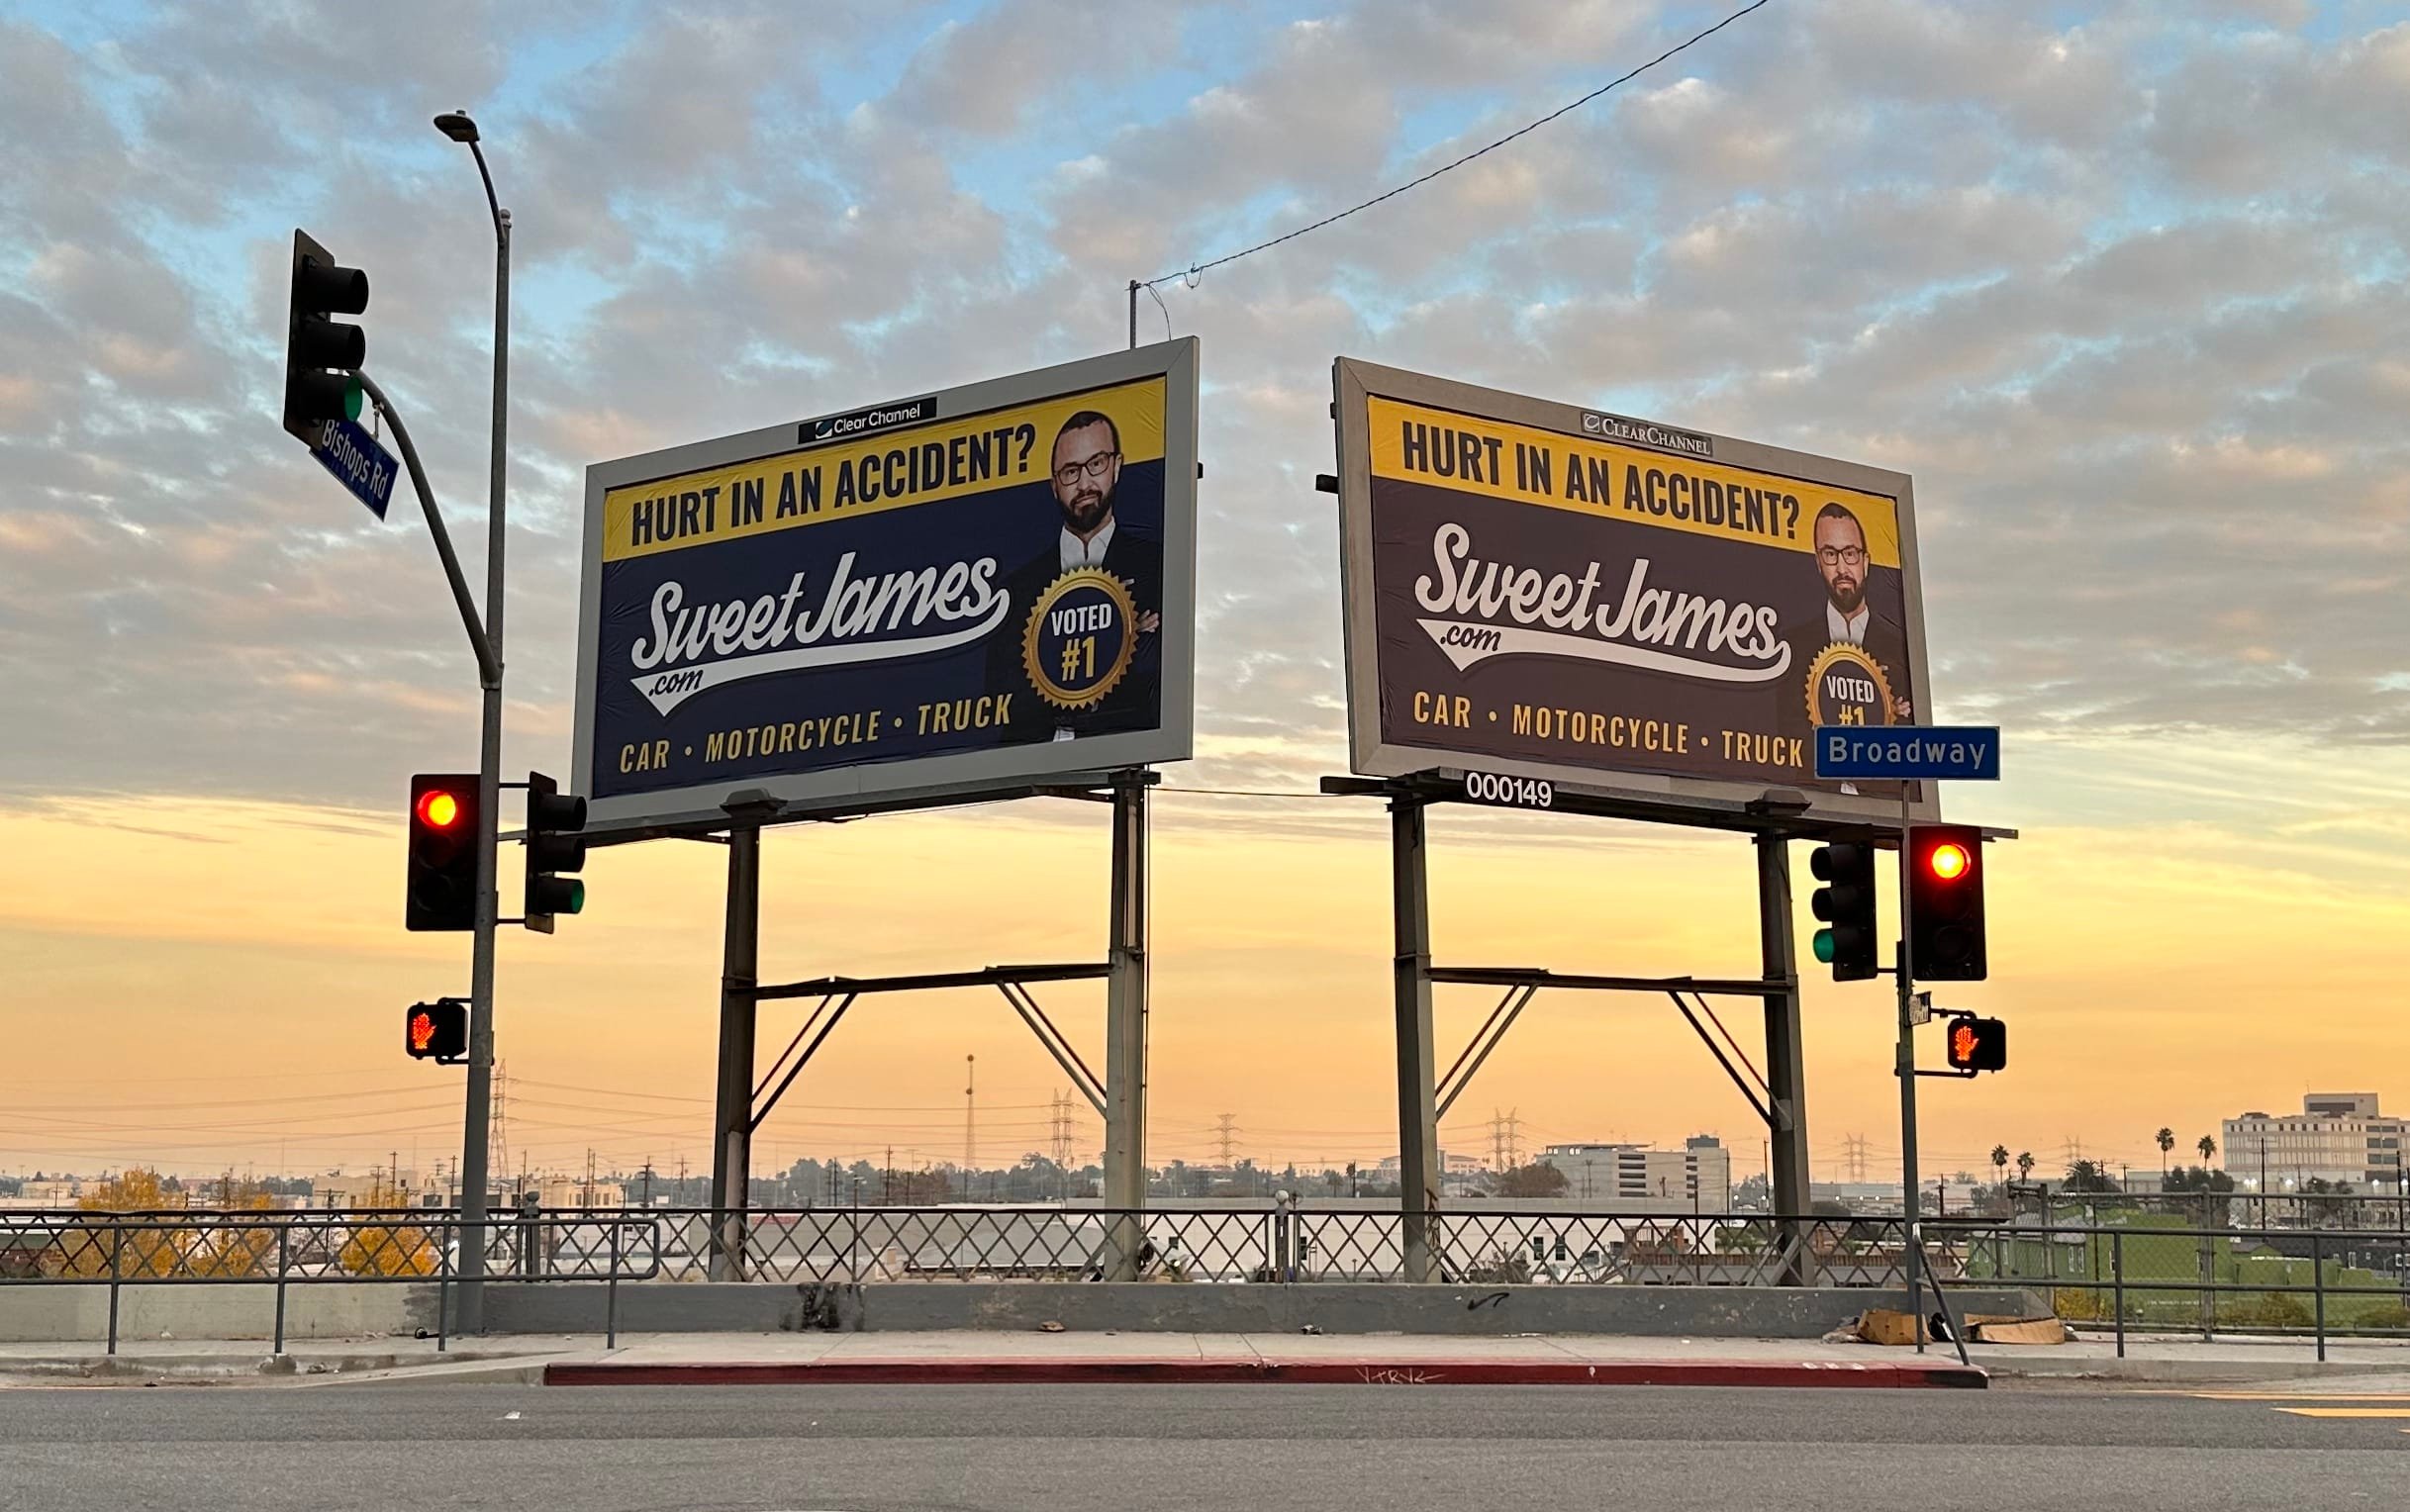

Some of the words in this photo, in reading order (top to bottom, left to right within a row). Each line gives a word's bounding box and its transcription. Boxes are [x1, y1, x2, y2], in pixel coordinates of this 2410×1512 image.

[834, 418, 867, 433] Clear
[869, 404, 920, 426] Channel
[322, 420, 371, 484] Bishops
[369, 462, 389, 500] Rd
[631, 486, 720, 547] HURT
[731, 476, 763, 528] IN
[776, 465, 822, 520] AN
[833, 424, 1035, 509] ACCIDENT?
[1402, 422, 1502, 485] HURT
[1516, 443, 1553, 496] IN
[1566, 451, 1611, 506] AN
[1623, 464, 1800, 540] ACCIDENT?
[1050, 603, 1112, 636] VOTED
[1439, 625, 1501, 653] .com
[1062, 636, 1096, 683] #1
[648, 669, 704, 698] .com
[1826, 675, 1875, 704] VOTED
[1413, 692, 1471, 730] CAR
[1513, 704, 1688, 755] MOTORCYCLE
[1722, 731, 1803, 769] TRUCK
[1838, 704, 1866, 726] #1
[620, 737, 670, 774] CAR
[705, 710, 881, 764] MOTORCYCLE
[917, 693, 1013, 736] TRUCK
[1829, 736, 1986, 770] Broadway
[1467, 772, 1552, 806] 000149
